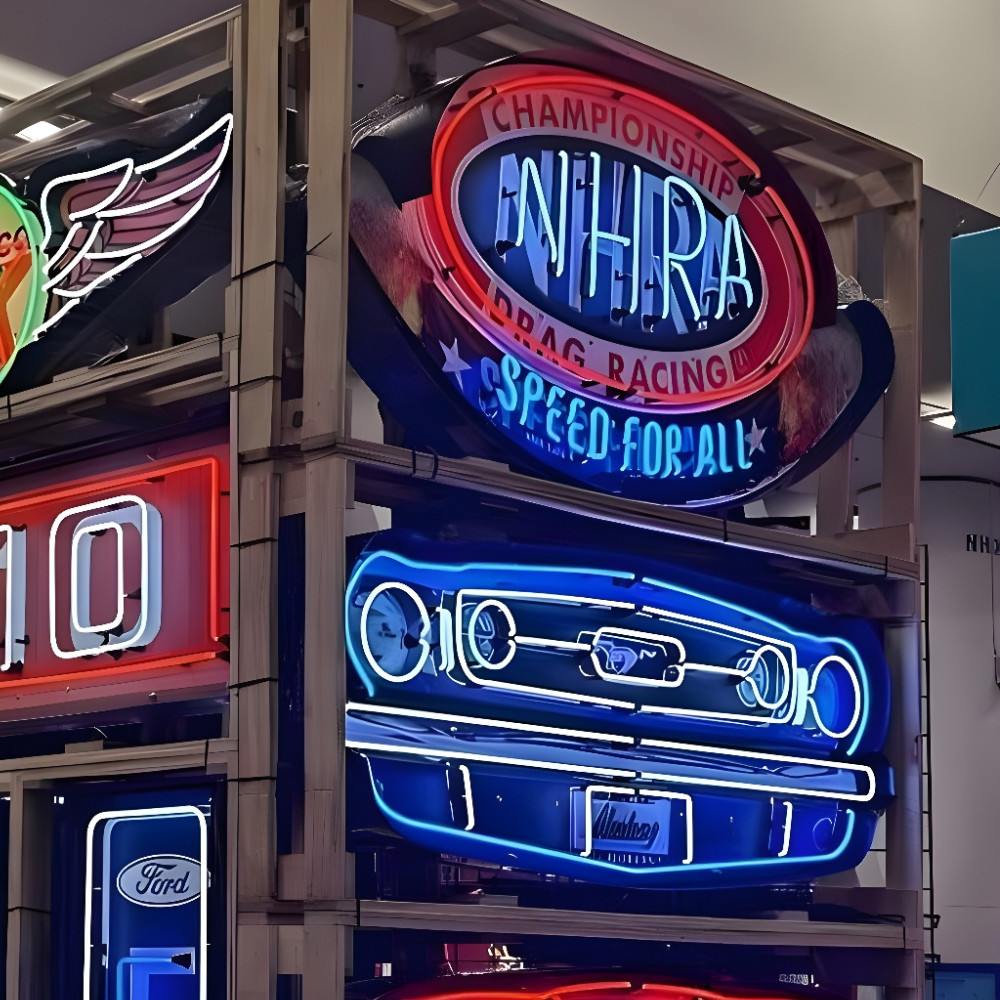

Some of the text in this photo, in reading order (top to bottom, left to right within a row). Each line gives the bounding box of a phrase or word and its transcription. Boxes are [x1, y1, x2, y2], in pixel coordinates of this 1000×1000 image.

[491, 93, 735, 202] CHAMPIONSHIP
[494, 150, 755, 334] NHRA
[487, 285, 729, 396] DRAG RACING
[484, 354, 610, 461] SPEED
[619, 416, 684, 478] FOR
[692, 418, 753, 478] ALL
[135, 862, 192, 896] Ford
